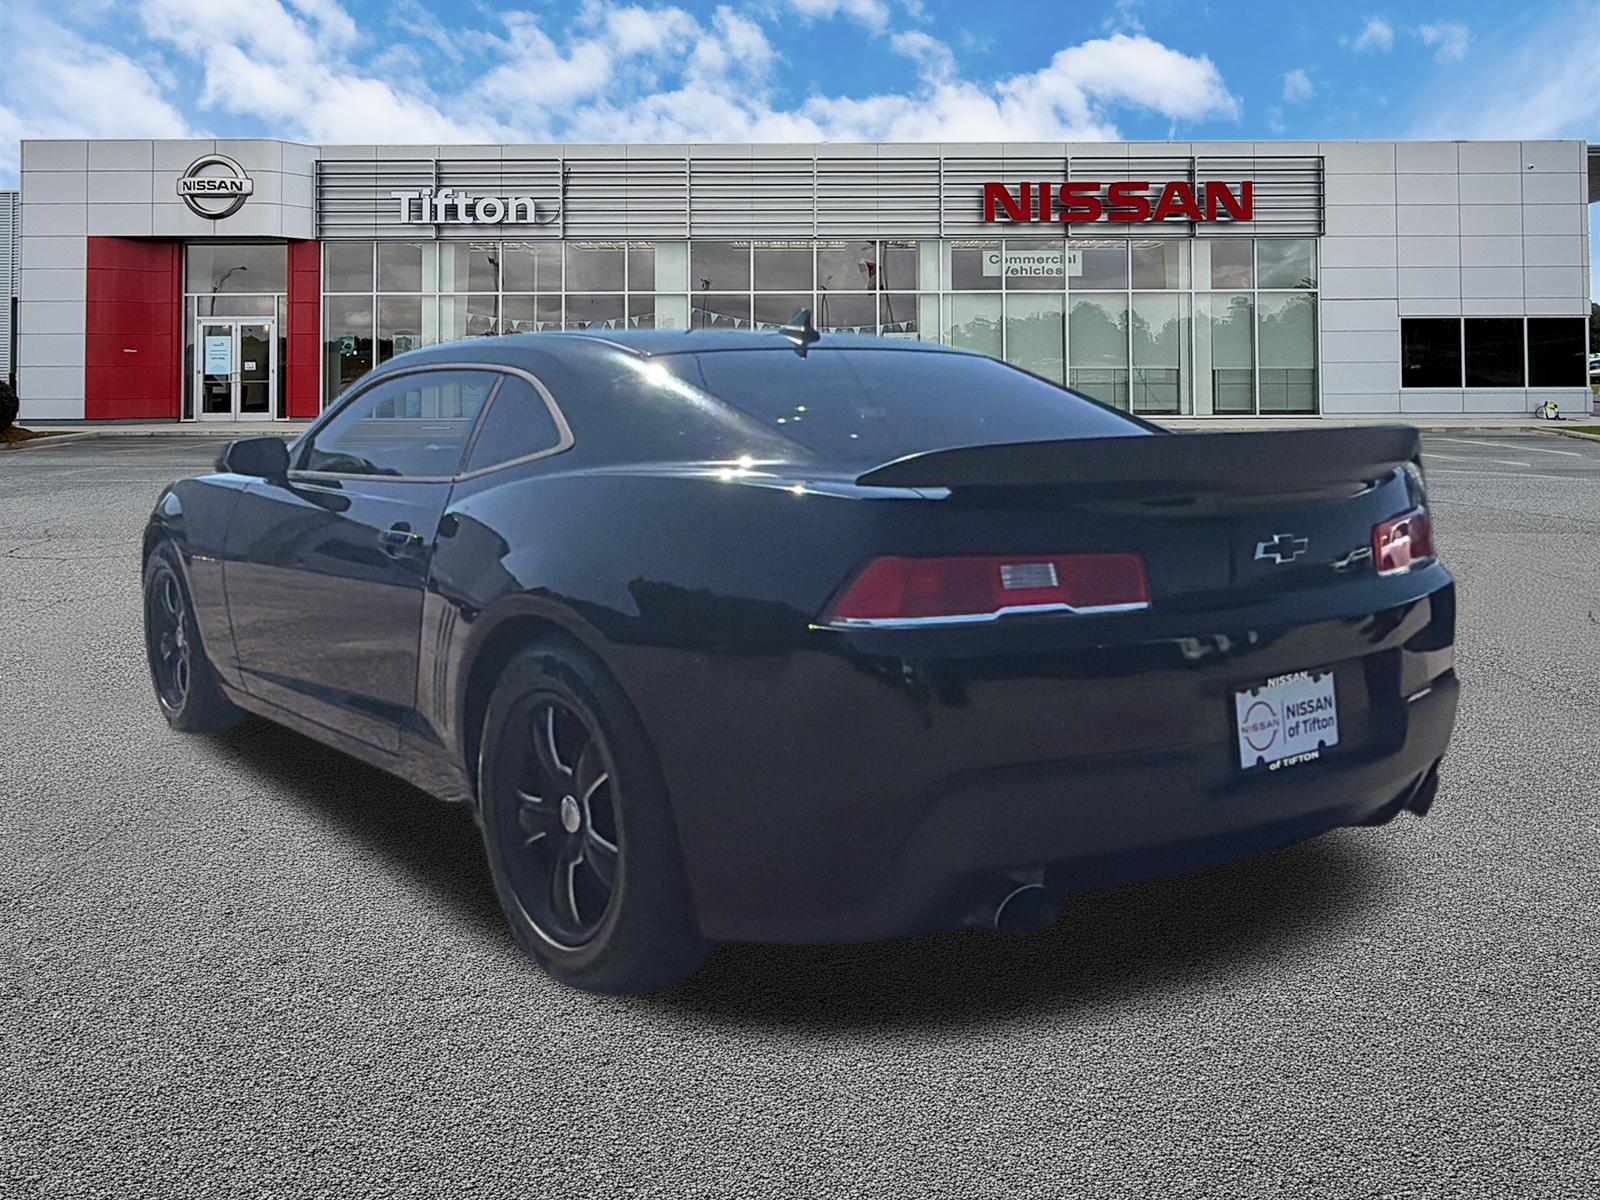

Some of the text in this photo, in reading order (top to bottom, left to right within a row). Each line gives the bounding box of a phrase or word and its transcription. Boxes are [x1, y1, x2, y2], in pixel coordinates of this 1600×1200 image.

[182, 180, 243, 191] NISSAN
[391, 187, 536, 224] Tifton
[983, 181, 1253, 223] NISSAN
[1267, 670, 1309, 688] NISSAN
[1286, 695, 1333, 720] NISSAN
[1241, 719, 1279, 734] NISSAN
[1288, 716, 1335, 738] of Tifton
[1269, 751, 1319, 771] of TIFTON
